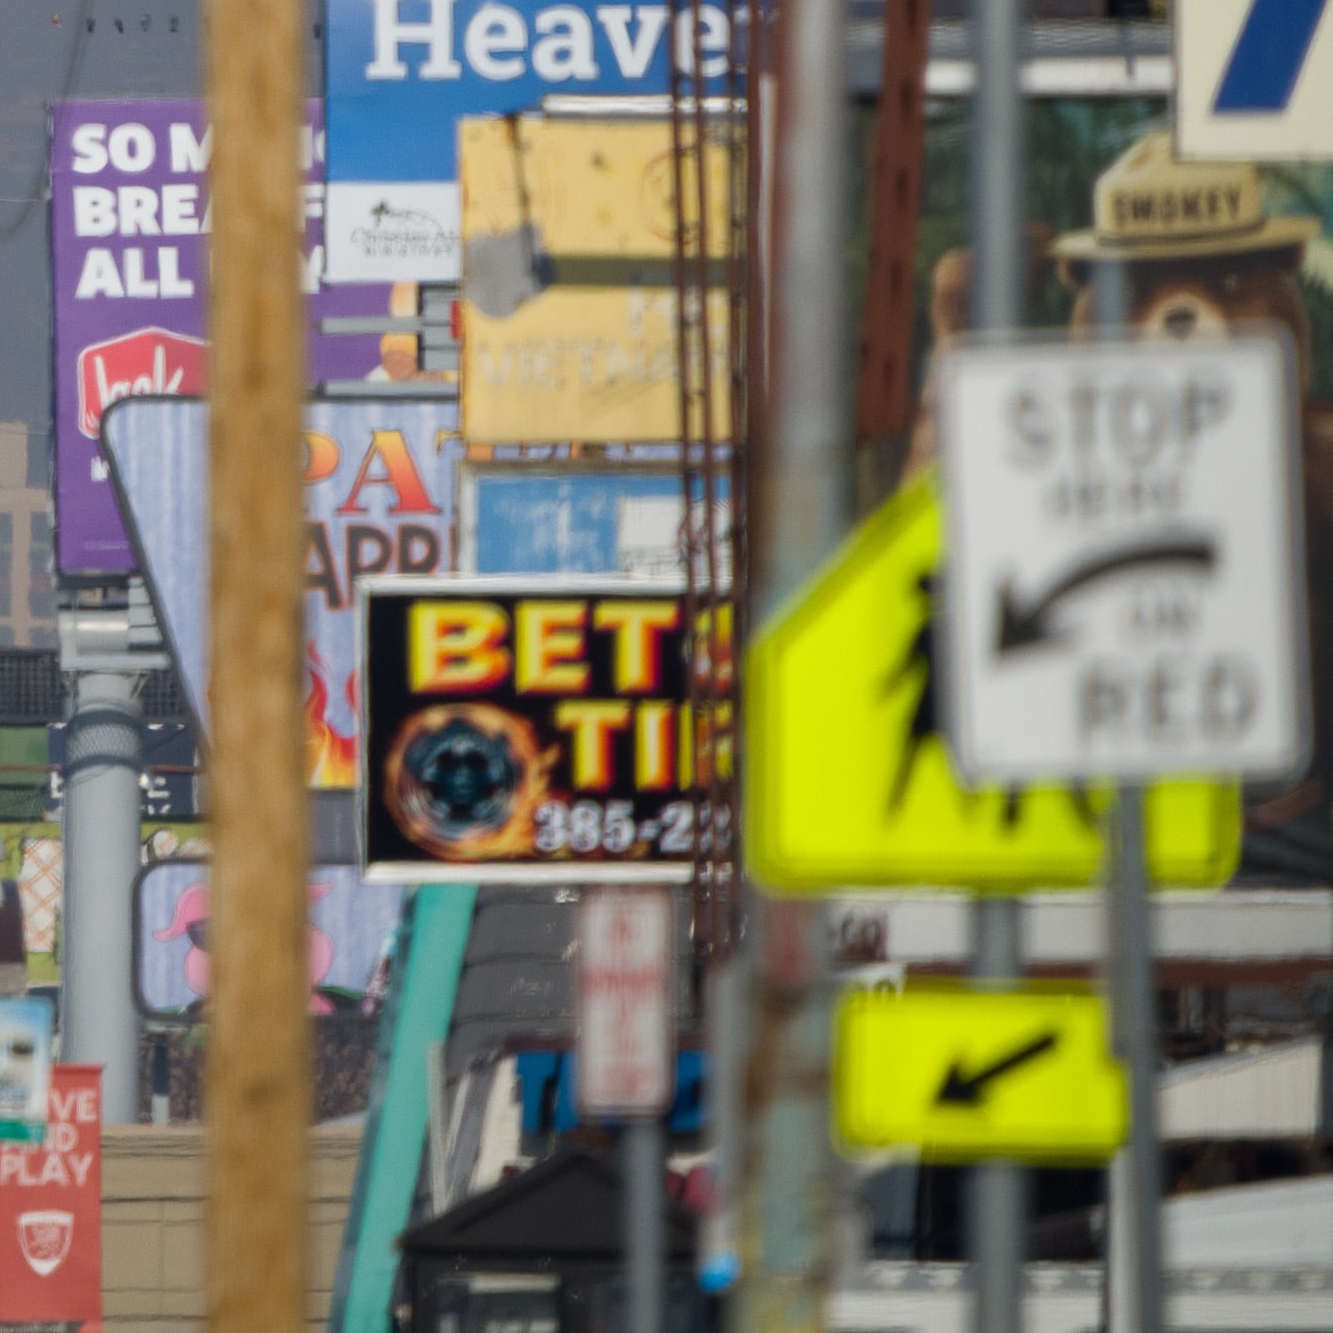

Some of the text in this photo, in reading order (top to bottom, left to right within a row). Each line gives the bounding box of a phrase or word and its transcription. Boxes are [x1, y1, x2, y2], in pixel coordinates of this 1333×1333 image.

[72, 122, 156, 174] SO
[1112, 185, 1243, 228] SMOKEY
[75, 246, 195, 300] ALL
[1004, 378, 1233, 466] STOP
[1079, 660, 1261, 740] RED
[0, 1152, 94, 1188] PLAY
